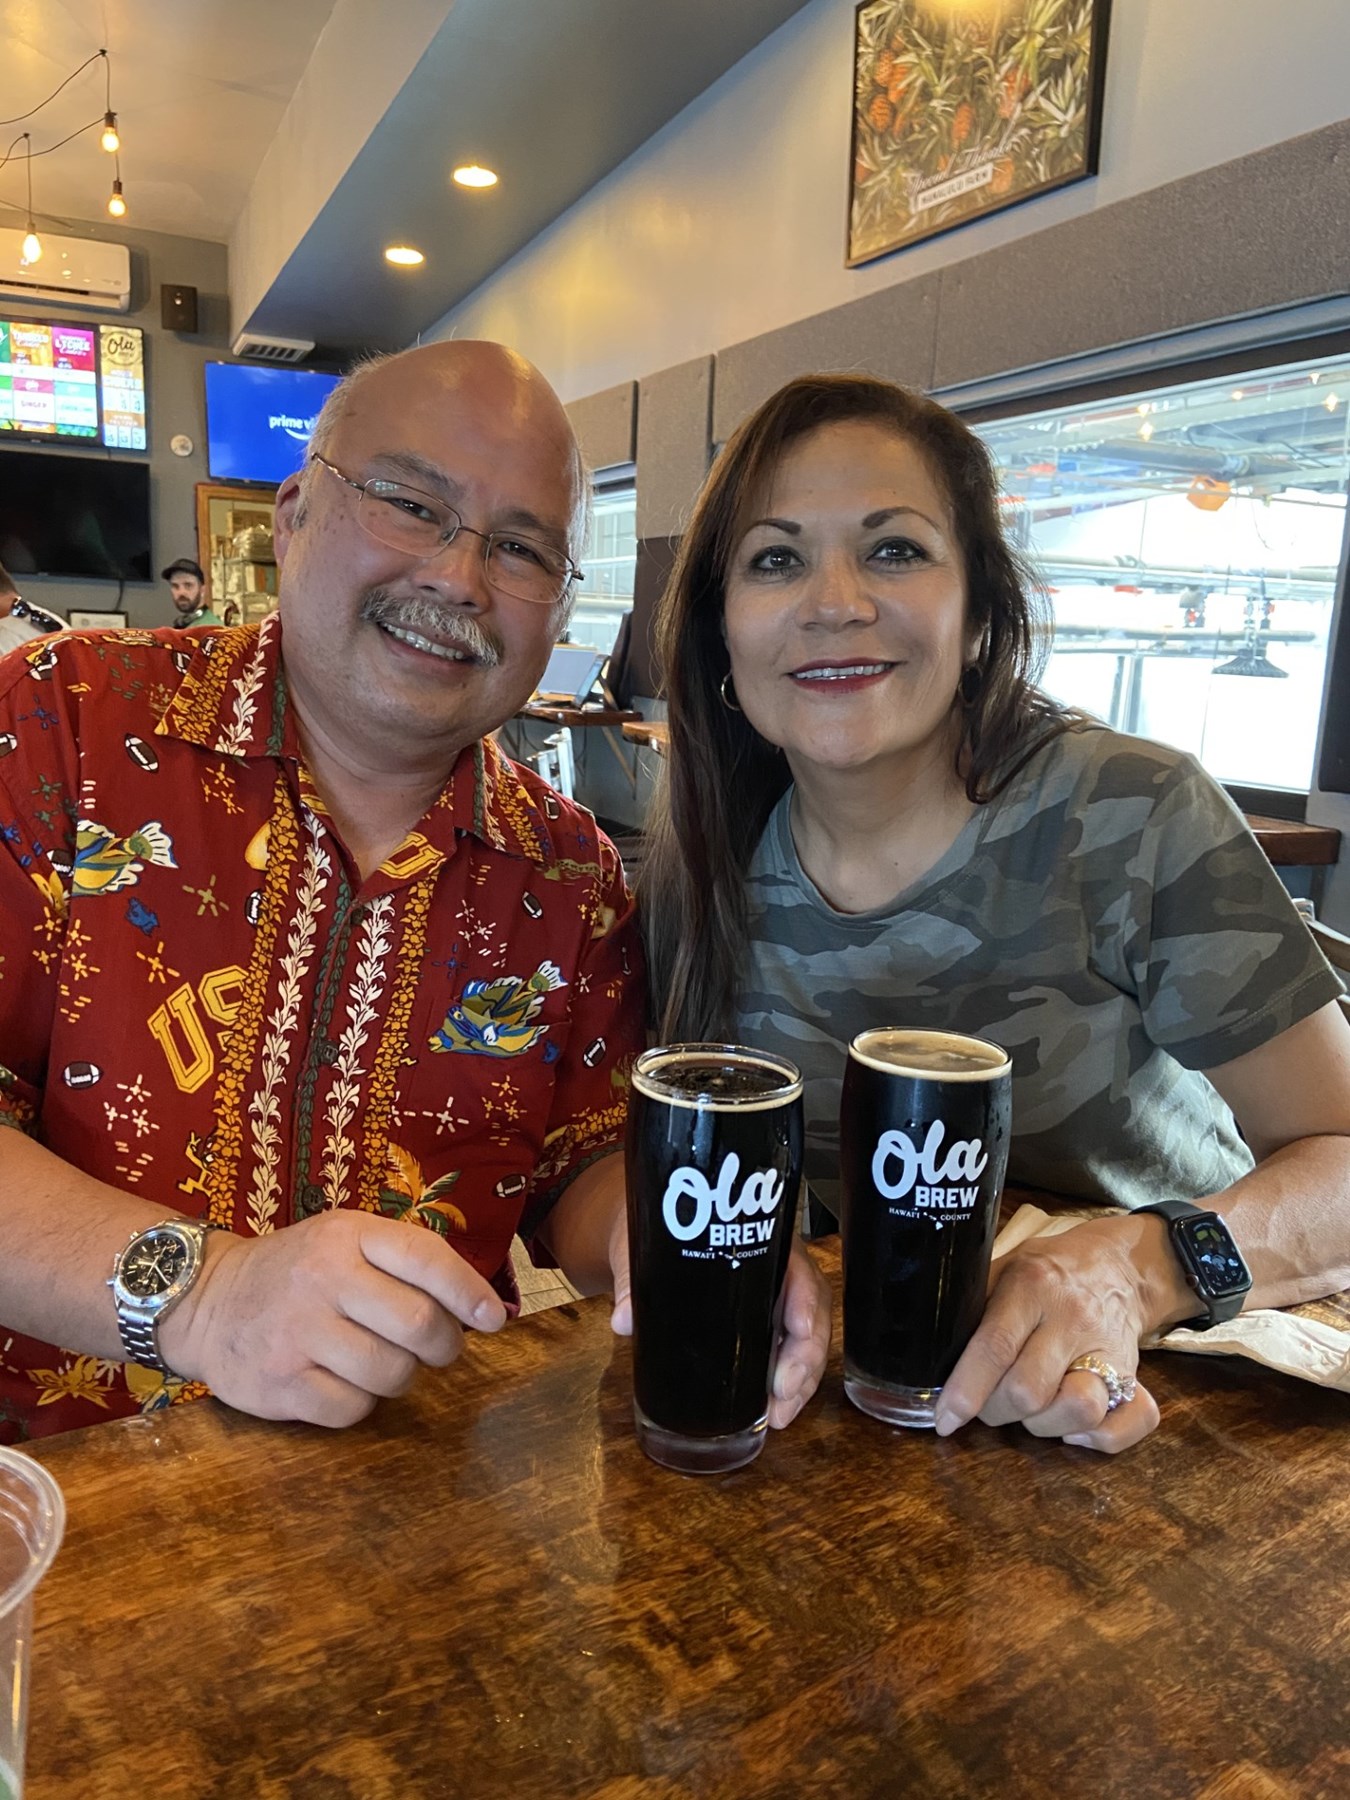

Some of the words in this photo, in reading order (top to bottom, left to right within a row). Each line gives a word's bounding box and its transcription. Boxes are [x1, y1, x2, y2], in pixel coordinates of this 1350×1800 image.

[269, 414, 304, 429] prime
[871, 1119, 989, 1200] Ola
[662, 1151, 784, 1241] Ola
[915, 1185, 980, 1208] BREW
[940, 1213, 972, 1221] COUNTY
[709, 1217, 776, 1246] BREW
[736, 1246, 769, 1259] COUNTY
